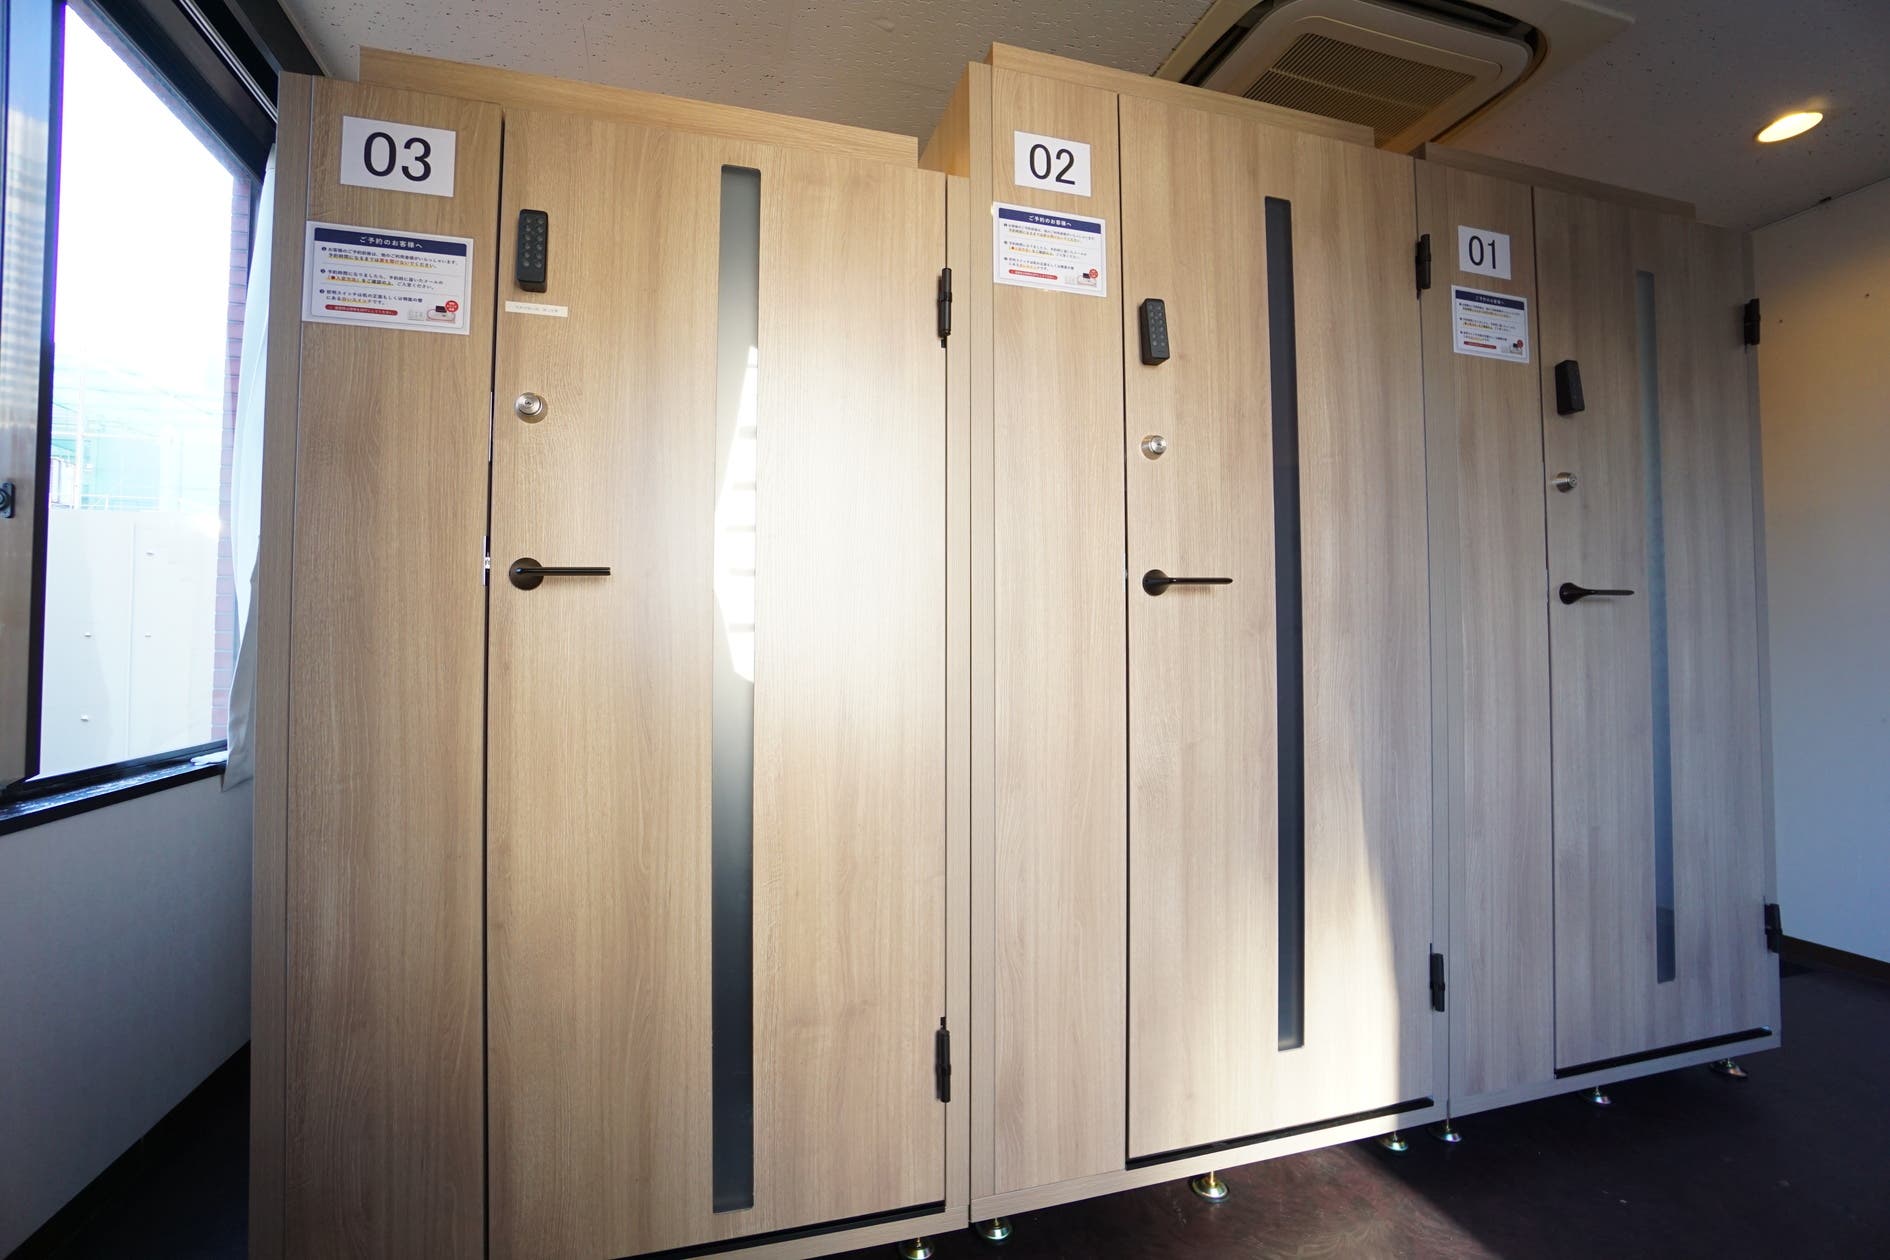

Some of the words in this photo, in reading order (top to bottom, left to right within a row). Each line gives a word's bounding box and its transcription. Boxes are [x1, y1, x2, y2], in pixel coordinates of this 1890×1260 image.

[363, 131, 432, 182] 03
[1029, 143, 1076, 186] 02
[1028, 214, 1072, 227] ご予約のお客様へ
[359, 235, 423, 249] ご予約のお客様へ
[1468, 235, 1497, 270] 01
